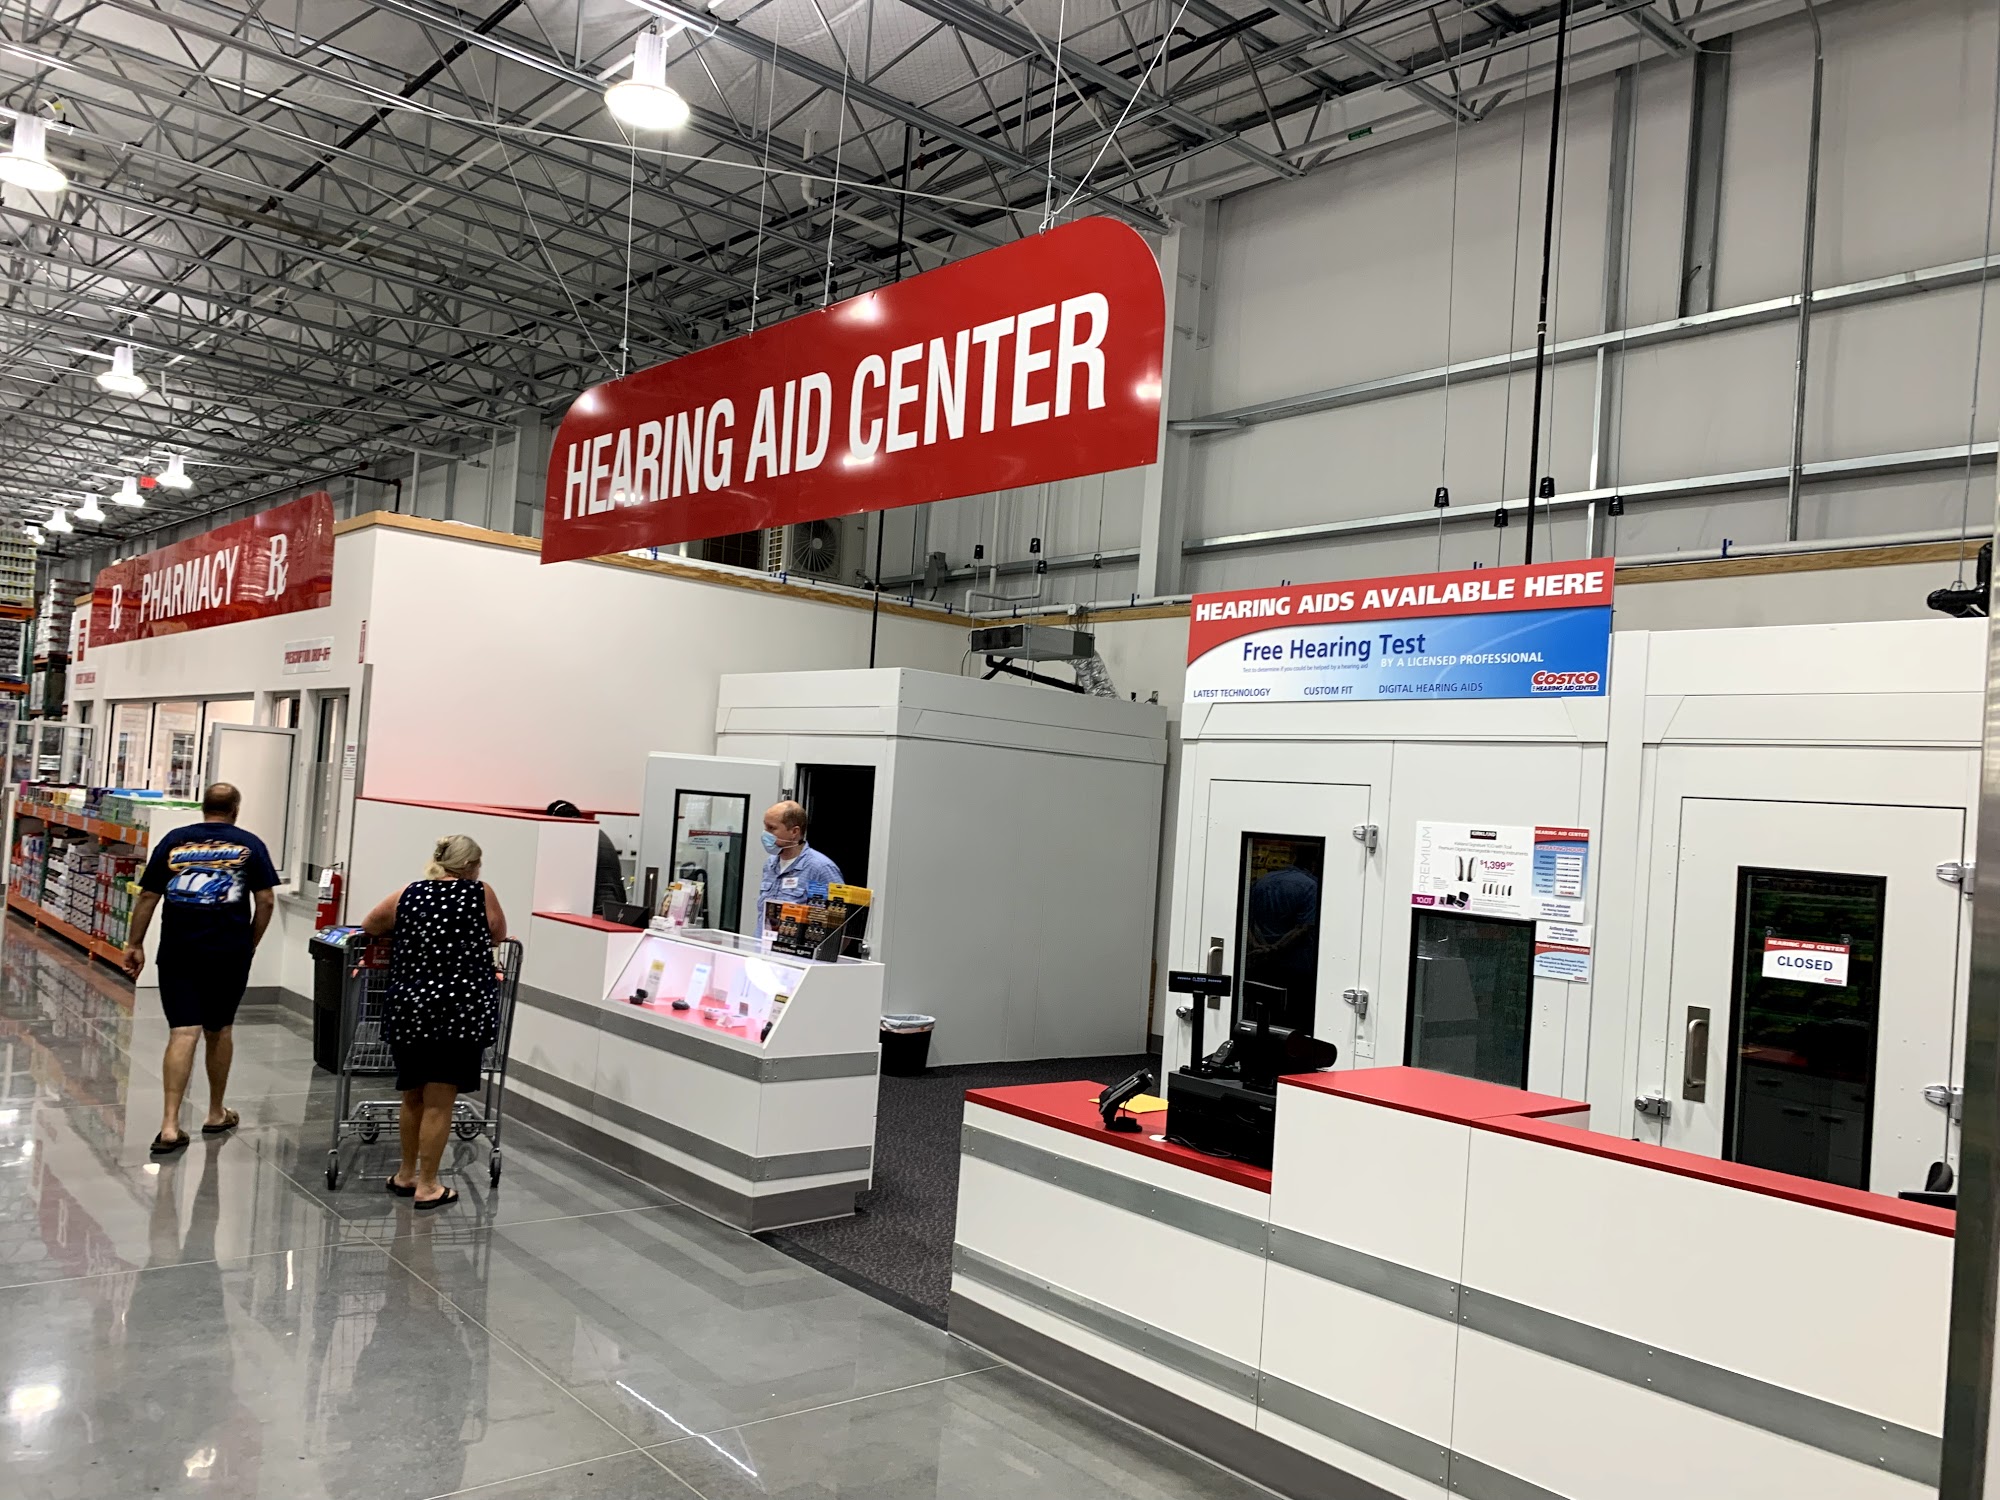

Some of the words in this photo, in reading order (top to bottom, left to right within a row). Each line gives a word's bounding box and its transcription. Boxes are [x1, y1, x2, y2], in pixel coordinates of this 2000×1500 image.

[563, 398, 735, 520] HEARING
[744, 371, 832, 483] AID
[849, 292, 1109, 459] CENTER
[139, 545, 240, 624] PHARMACY
[1195, 597, 1291, 622] HEARING
[1297, 591, 1354, 615] AIDS
[1361, 578, 1515, 609] AVAILABLE
[1524, 571, 1604, 598] HERE
[1243, 642, 1283, 661] Free
[1290, 636, 1371, 662] Hearing
[1379, 633, 1426, 655] Test
[1380, 658, 1394, 668] BY
[1396, 658, 1404, 667] A
[1407, 655, 1456, 667] LICENSED
[1459, 652, 1544, 665] PROFESSIONAL
[1533, 671, 1598, 685] COSTCO
[1193, 690, 1218, 698] LATEST
[1220, 688, 1271, 697] TECHNOLOGY
[1304, 687, 1339, 695] CUSTOM
[1341, 686, 1353, 694] FIT
[1378, 684, 1413, 694] DIGITAL
[1416, 683, 1457, 693] HEARING
[1460, 682, 1483, 692] AIDS
[1418, 826, 1432, 893] PREMIUM
[1767, 939, 1800, 948] HEARING
[1816, 944, 1846, 953] CENTER
[1777, 955, 1833, 971] CLOSED
